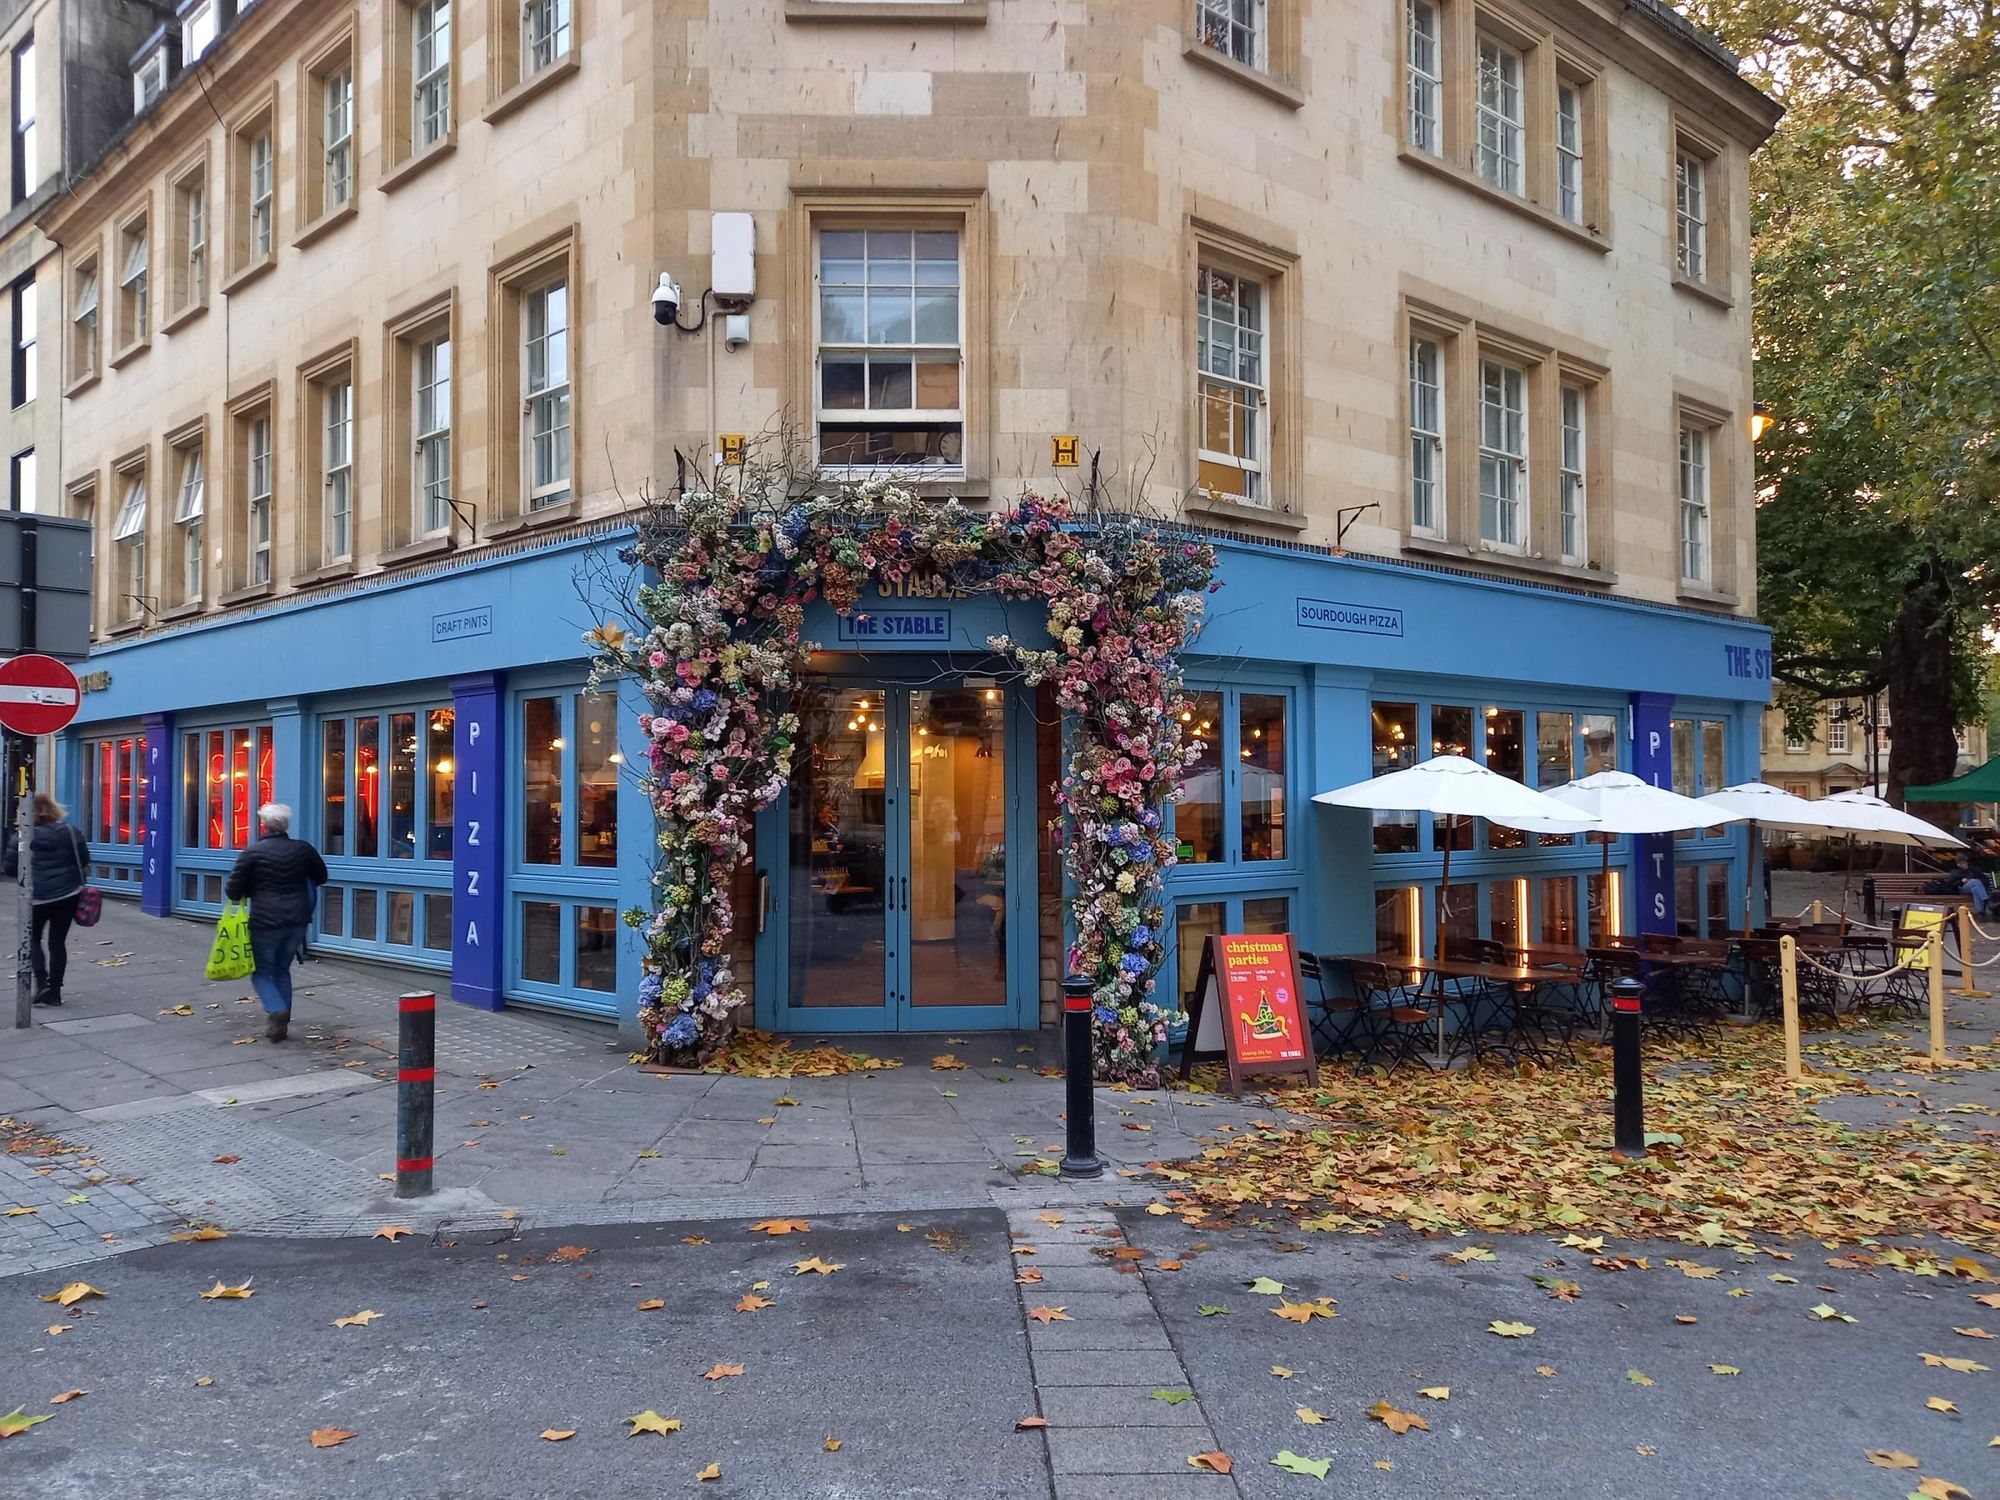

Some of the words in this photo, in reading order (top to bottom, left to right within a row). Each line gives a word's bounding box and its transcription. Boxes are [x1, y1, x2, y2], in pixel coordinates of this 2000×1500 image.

[1060, 454, 1070, 462] 37
[436, 619, 462, 634] CRAFT
[464, 614, 488, 629] PINTS
[846, 616, 878, 634] THE
[883, 616, 944, 634] STABLE
[1301, 606, 1367, 626] SOURDOUGH
[1369, 614, 1399, 629] PIZZA
[1725, 645, 1751, 678] THE
[149, 748, 158, 875] PINTS
[466, 721, 480, 946] PIZZA
[1649, 731, 1665, 919] PITS
[1226, 940, 1284, 953] christmas
[1228, 953, 1270, 968] parties
